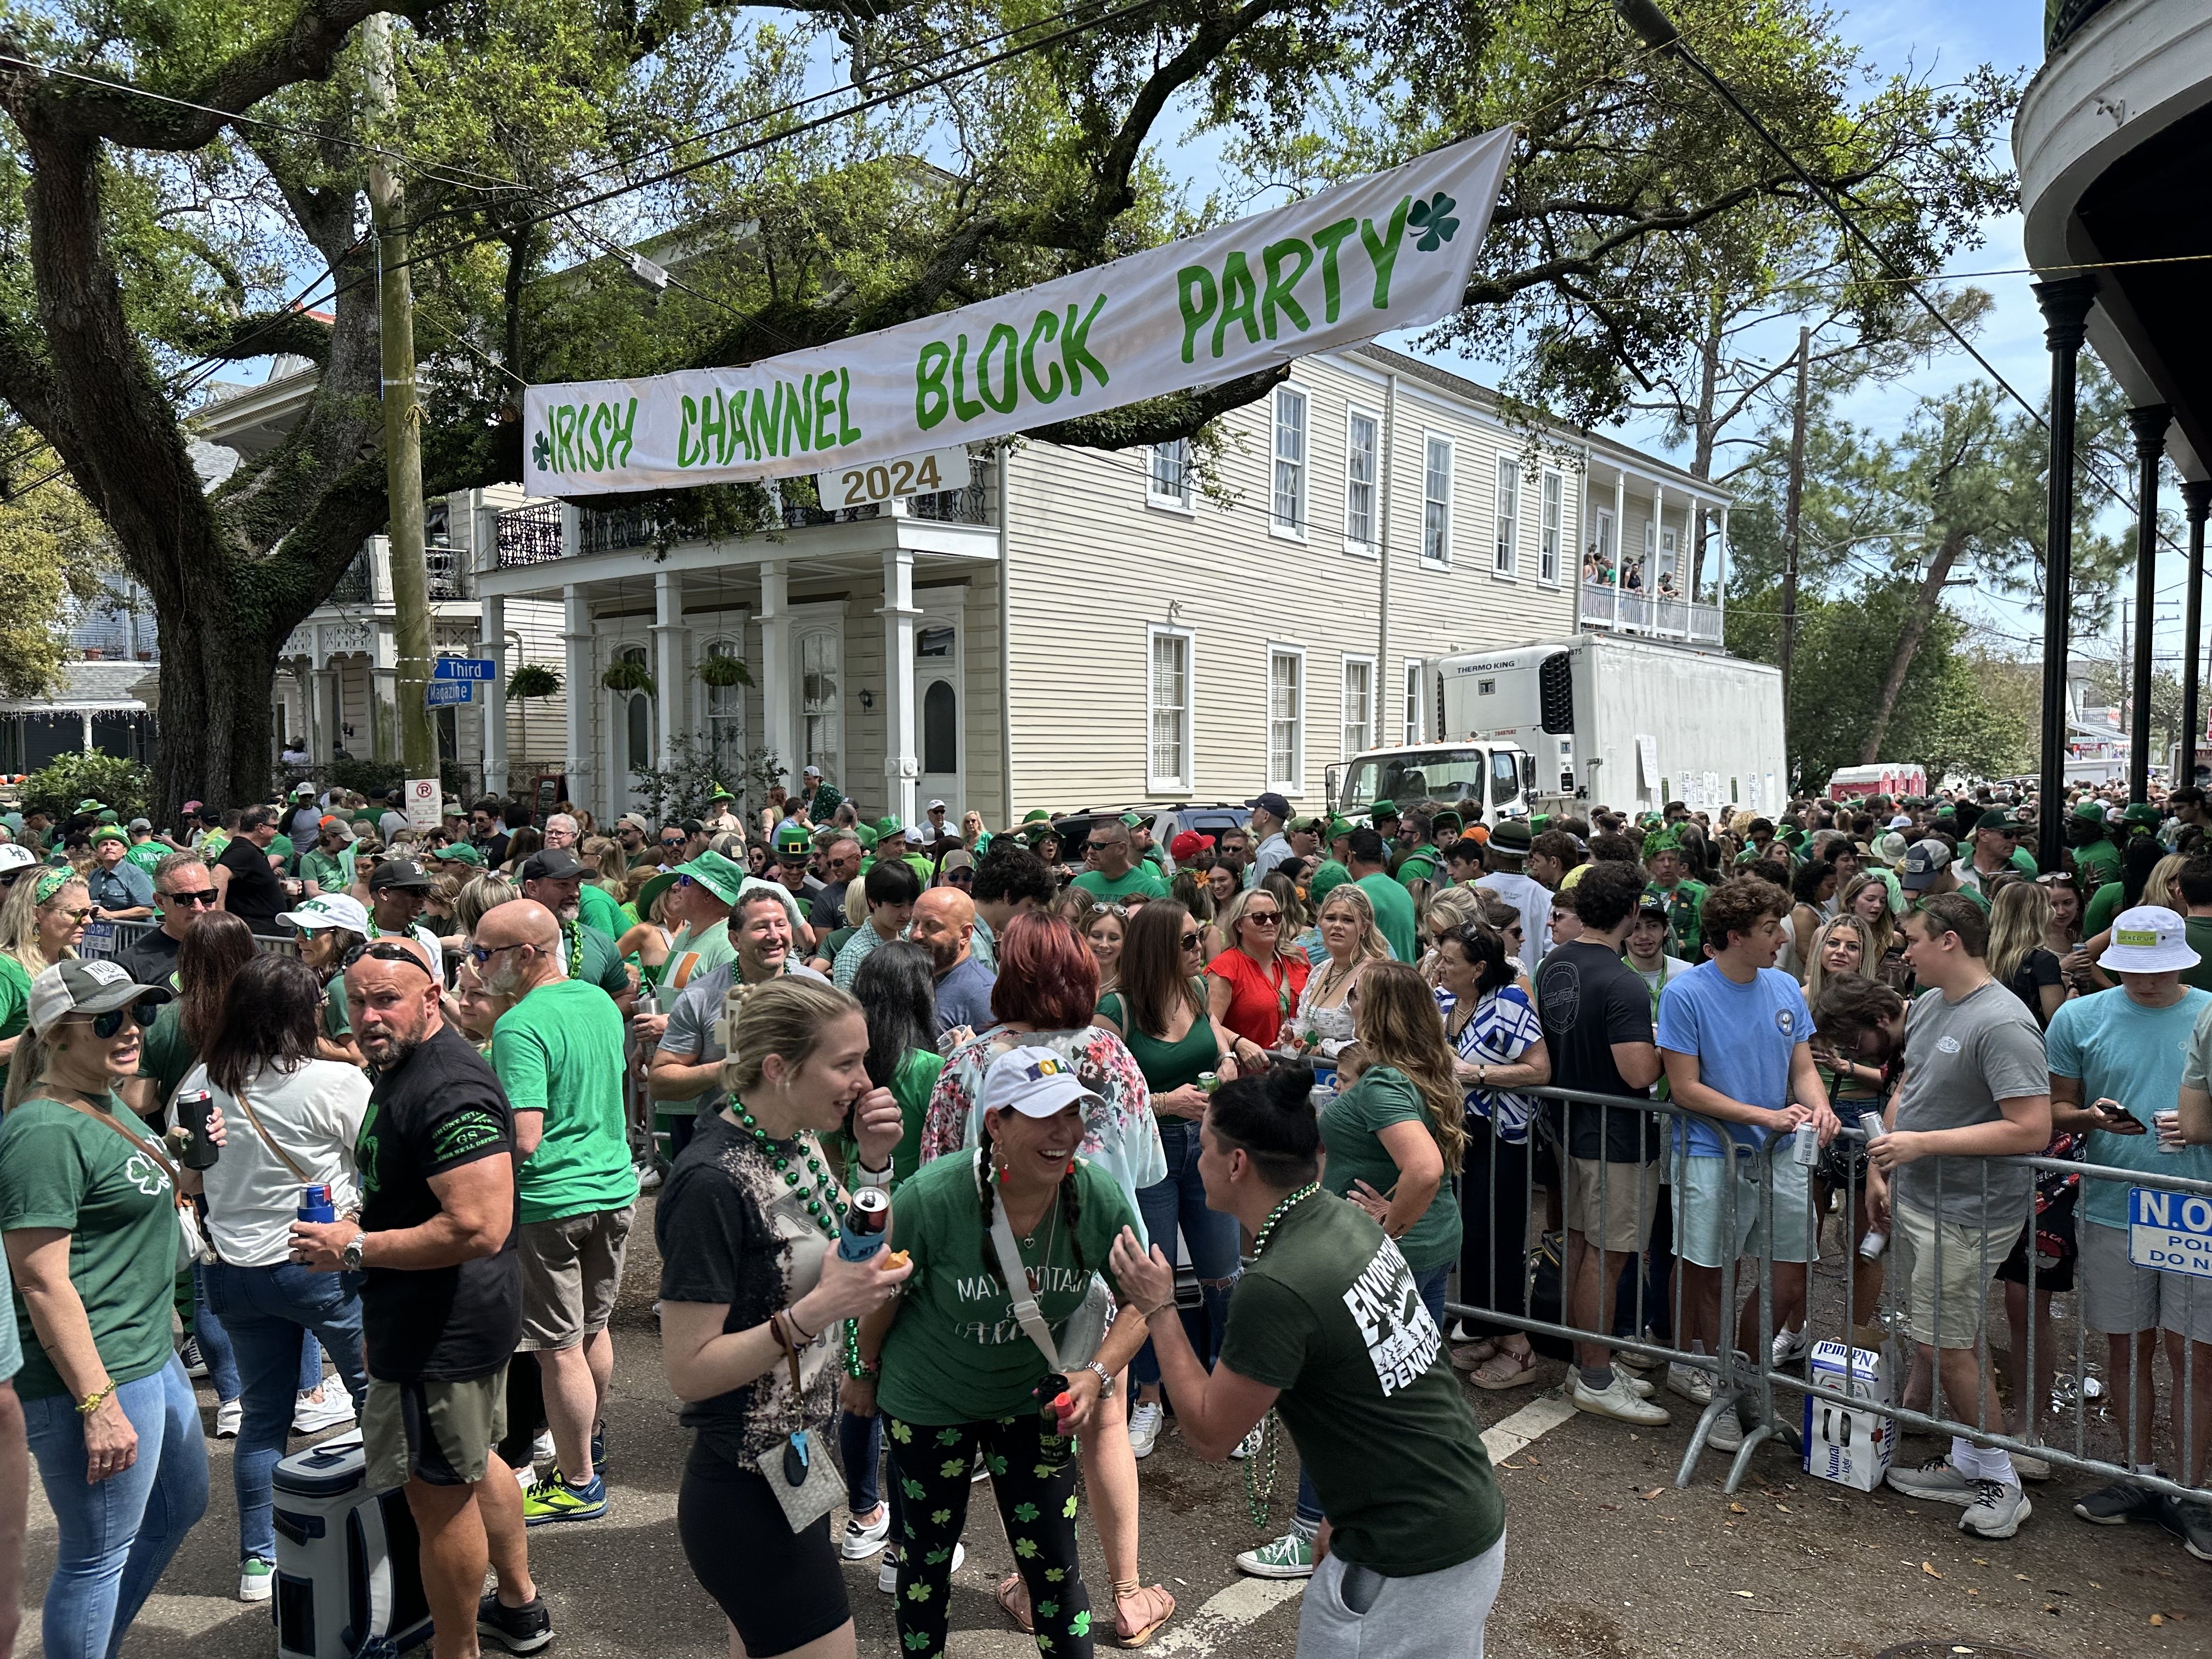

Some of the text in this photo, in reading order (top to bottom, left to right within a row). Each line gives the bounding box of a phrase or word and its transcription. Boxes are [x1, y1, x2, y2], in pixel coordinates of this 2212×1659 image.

[549, 195, 1413, 475] IRISH CHANNEL BLOCK PARTY
[841, 455, 943, 505] 2024
[1570, 648, 1582, 656] 875
[448, 661, 482, 678] Third
[1457, 660, 1515, 674] THERMO KING
[430, 682, 467, 703] Magazine
[695, 873, 722, 894] IRISH
[461, 1111, 481, 1121] STYL
[456, 1130, 478, 1144] GS
[476, 1134, 499, 1146] DEFEND
[2150, 1250, 2212, 1270] DO N
[1342, 1233, 1409, 1347] ENVIROTH
[1818, 1342, 1873, 1367] Naural
[1826, 1445, 1839, 1480] Natural
